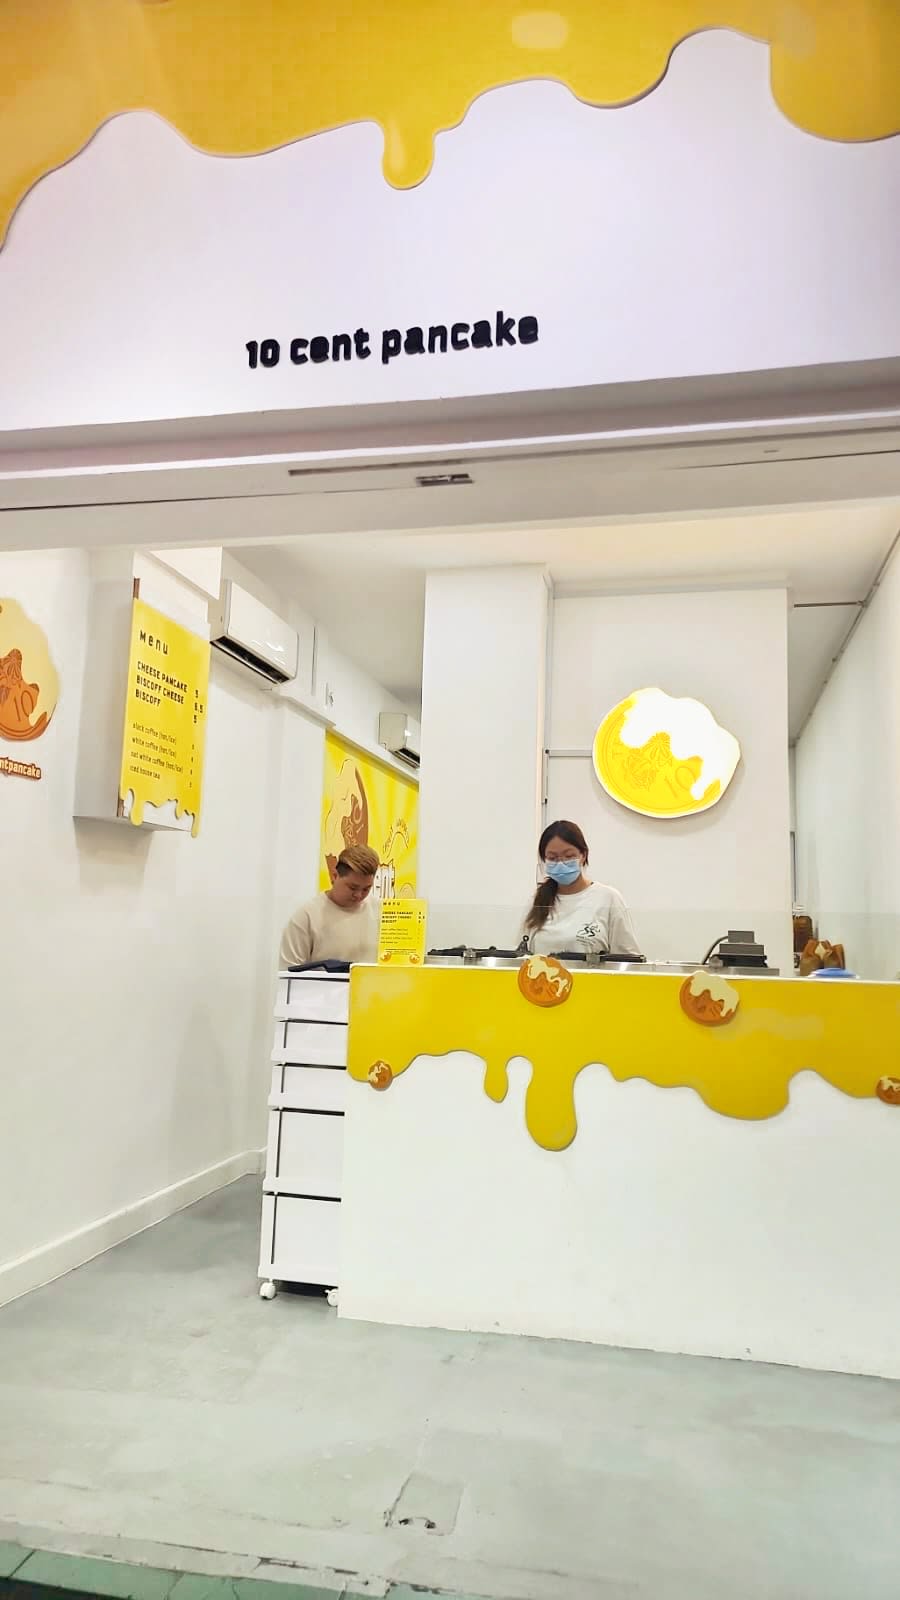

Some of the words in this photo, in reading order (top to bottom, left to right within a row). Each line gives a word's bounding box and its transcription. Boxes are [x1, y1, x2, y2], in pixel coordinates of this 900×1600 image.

[245, 338, 280, 369] 10
[290, 327, 371, 365] cent
[381, 310, 539, 364] pancake
[139, 629, 168, 655] Menu
[136, 674, 161, 693] BISCOFF
[163, 687, 184, 705] CHEESE
[137, 660, 160, 680] CHEESE
[161, 673, 188, 693] PANCAKE
[135, 688, 161, 707] BISCOFF
